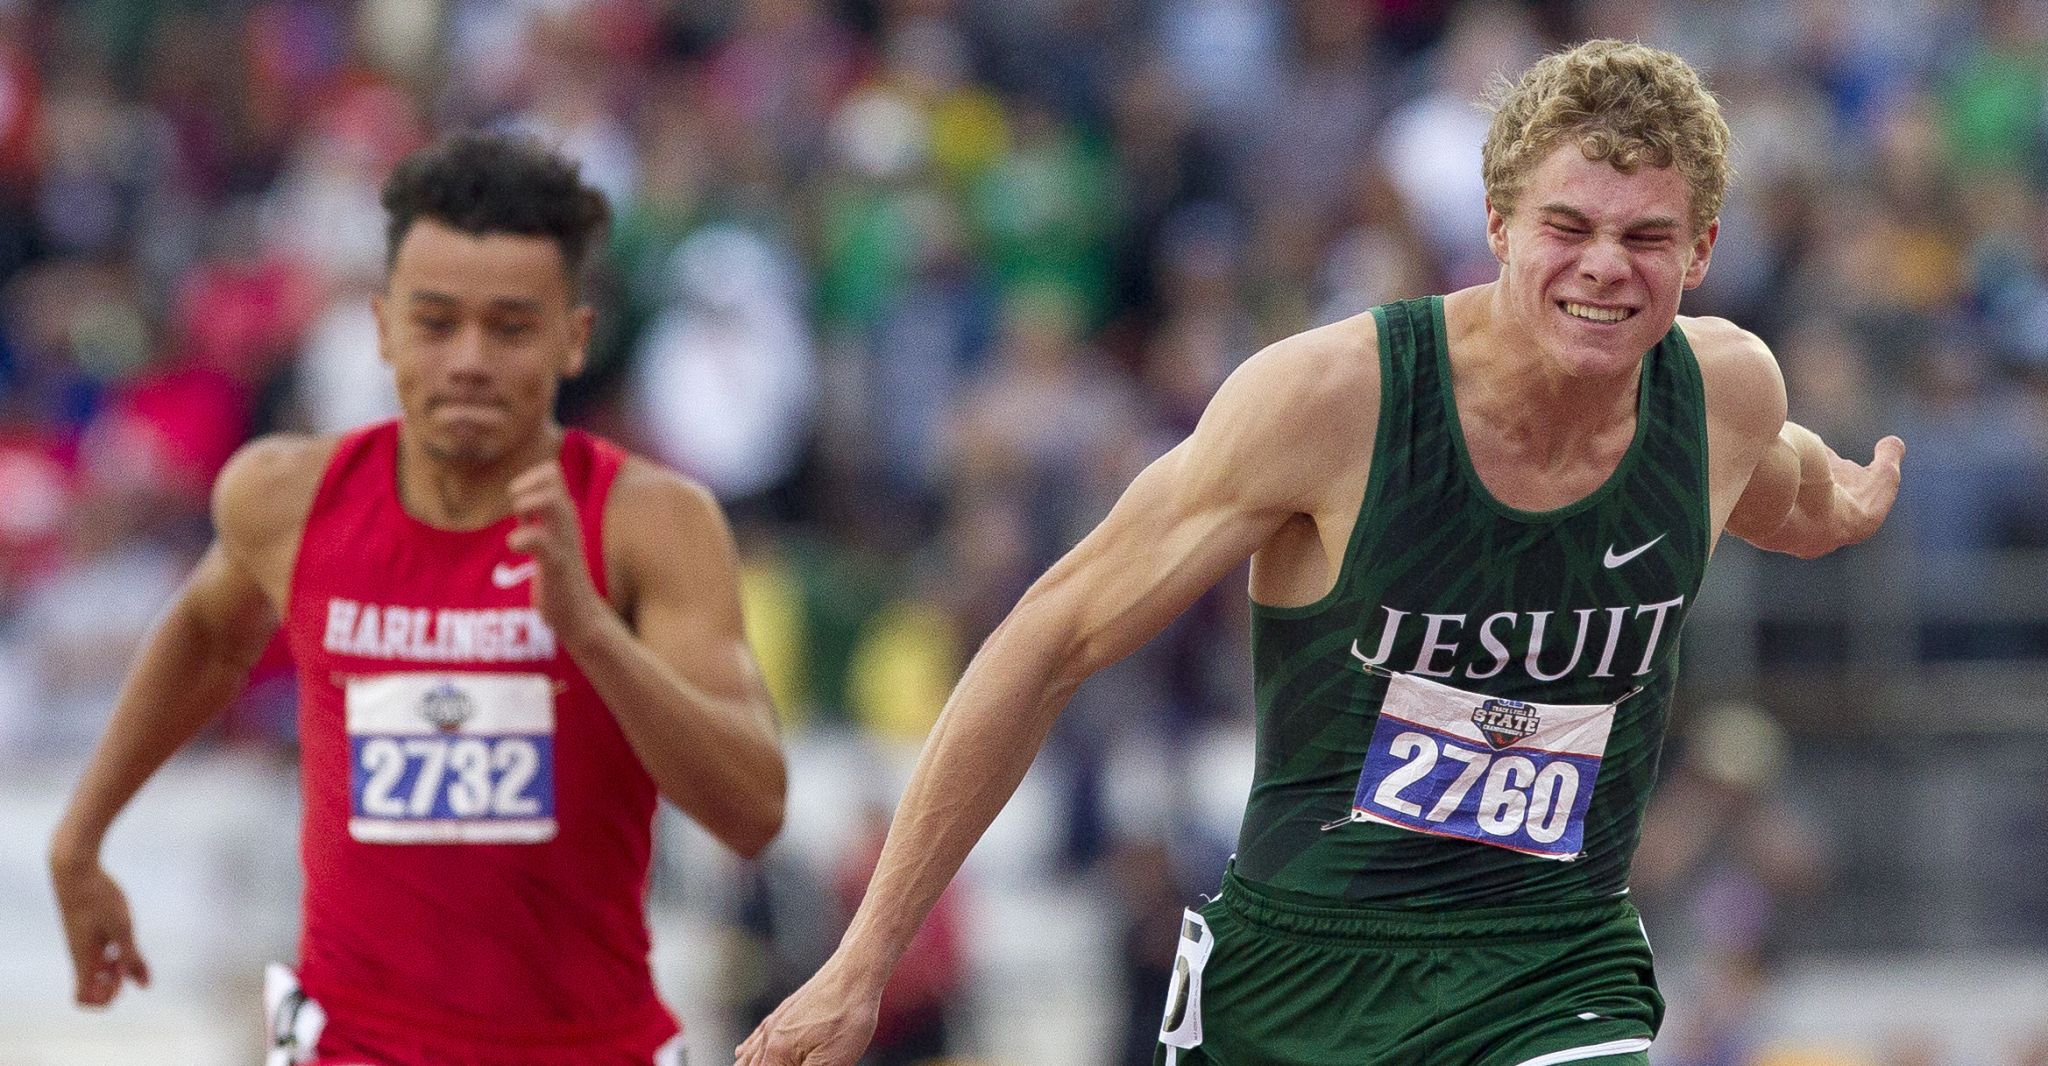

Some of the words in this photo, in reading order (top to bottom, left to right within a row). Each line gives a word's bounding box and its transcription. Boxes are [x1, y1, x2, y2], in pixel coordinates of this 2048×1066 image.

[323, 598, 556, 662] HARLINGEN
[1351, 595, 1684, 681] JESUIT
[1473, 708, 1539, 733] STATE
[361, 739, 541, 817] 2732
[1374, 732, 1579, 843] 2760
